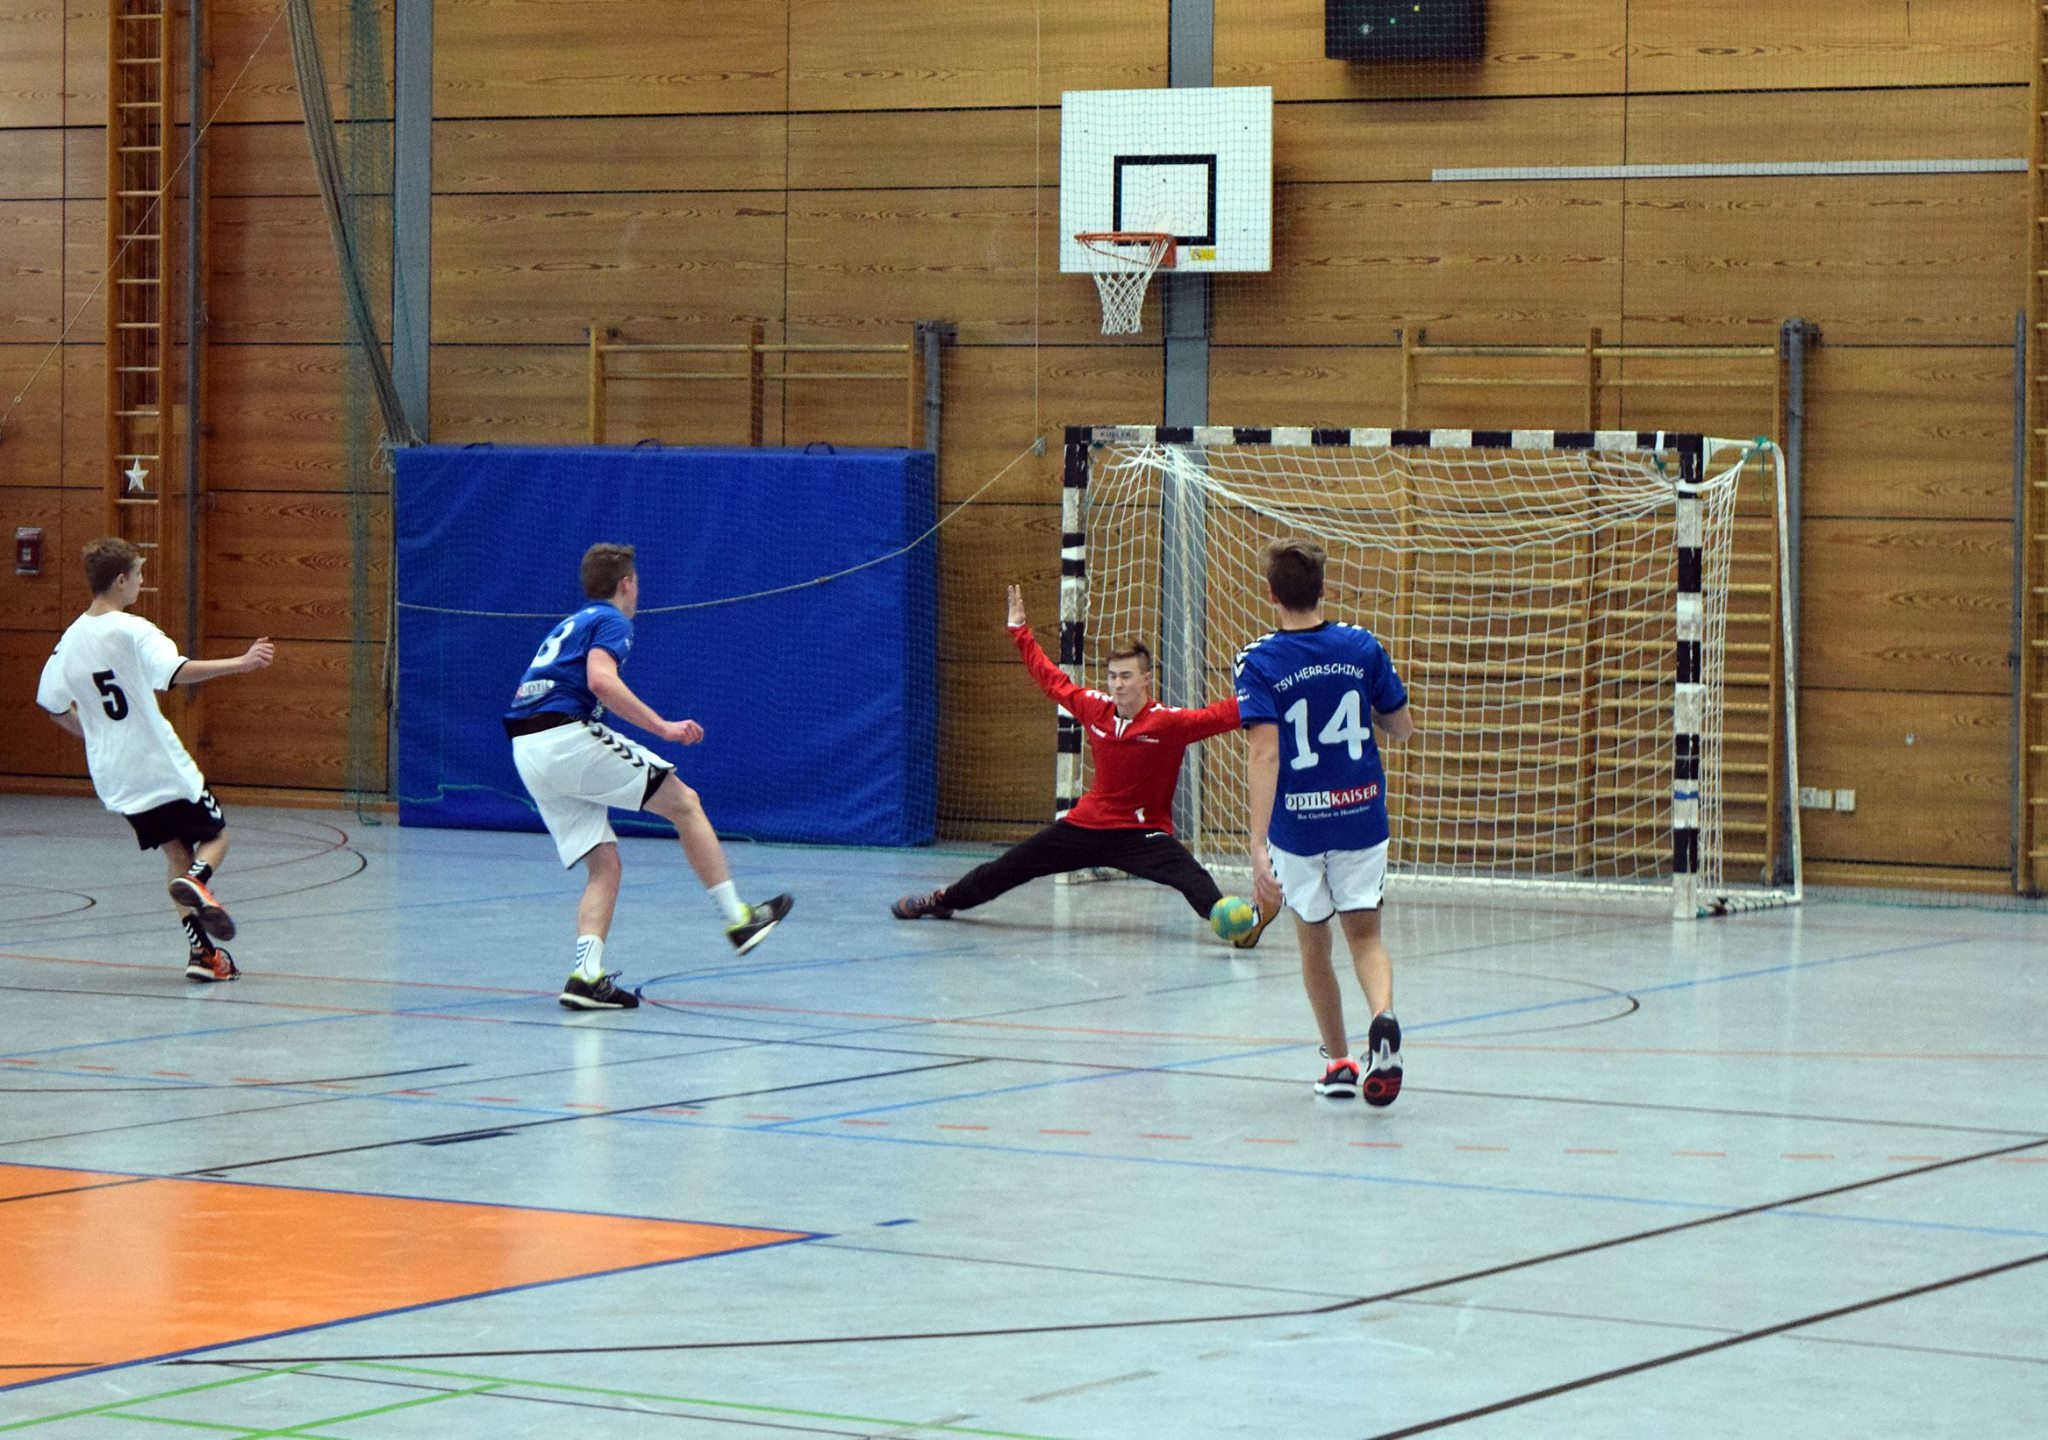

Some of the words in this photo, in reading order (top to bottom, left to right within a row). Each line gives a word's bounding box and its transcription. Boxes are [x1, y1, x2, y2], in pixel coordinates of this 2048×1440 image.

[92, 669, 129, 721] 5
[1272, 674, 1294, 693] TSV
[1294, 662, 1365, 680] HERRSCHING
[1284, 689, 1371, 770] 14
